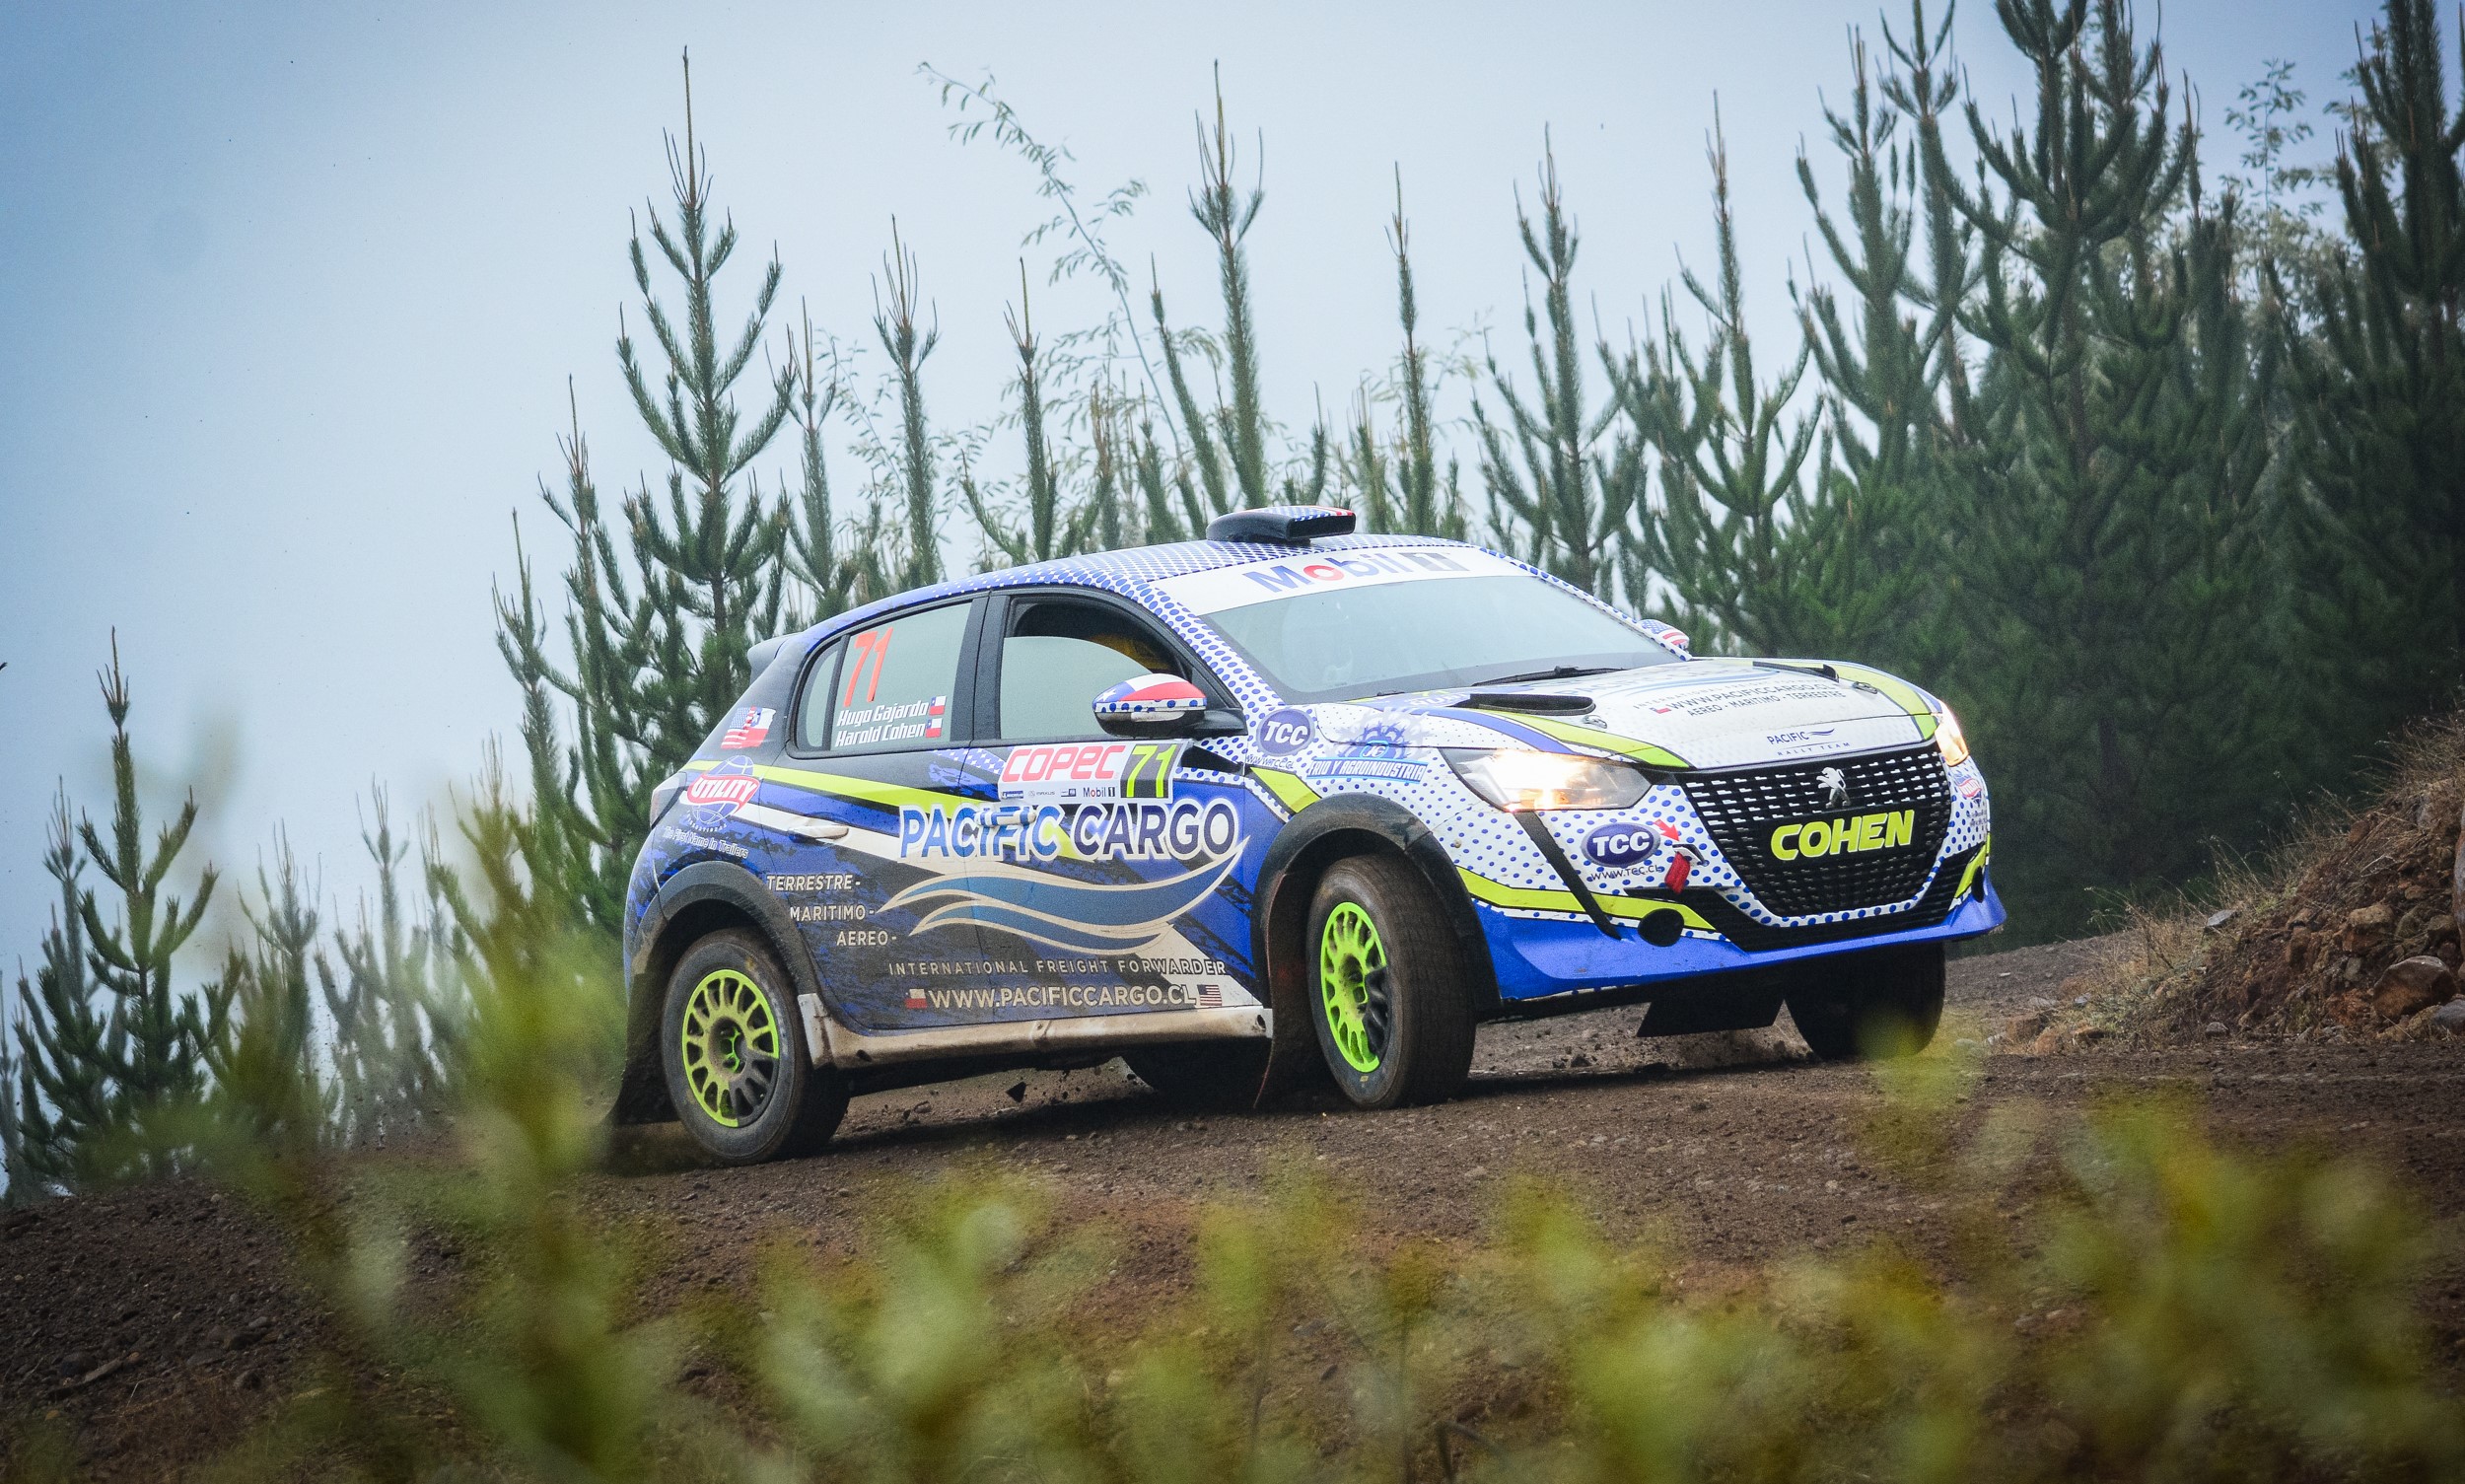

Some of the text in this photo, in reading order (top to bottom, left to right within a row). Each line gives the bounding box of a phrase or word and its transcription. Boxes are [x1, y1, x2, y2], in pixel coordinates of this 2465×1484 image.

[1242, 552, 1470, 593] Mobil 1
[843, 627, 893, 708] 71
[837, 700, 929, 727] Hugo Gajardo
[1687, 704, 1723, 717] AEREO
[1729, 695, 1781, 709] MARITIMO
[835, 723, 926, 747] Harold Cohen
[1263, 721, 1309, 745] TCC
[1767, 732, 1810, 744] PACIFIC
[1778, 742, 1850, 756] RALLY TEAM
[1002, 743, 1177, 798] COPEC 71
[1330, 760, 1339, 775] Y
[1339, 760, 1427, 780] AGROINDUSTRIA
[691, 778, 758, 803] UTILITY
[1084, 787, 1106, 798] Mobil
[899, 800, 1237, 860] PACIFIC CARGO
[1770, 809, 1915, 862] COHEN
[1592, 831, 1651, 857] TCC
[1590, 864, 1662, 881] WWW.TCC.CL
[888, 958, 1227, 976] INTERNATIONAL FREIGHT FORWARDER
[929, 984, 1198, 1009] WWW.PACIFICCARGO.CL
